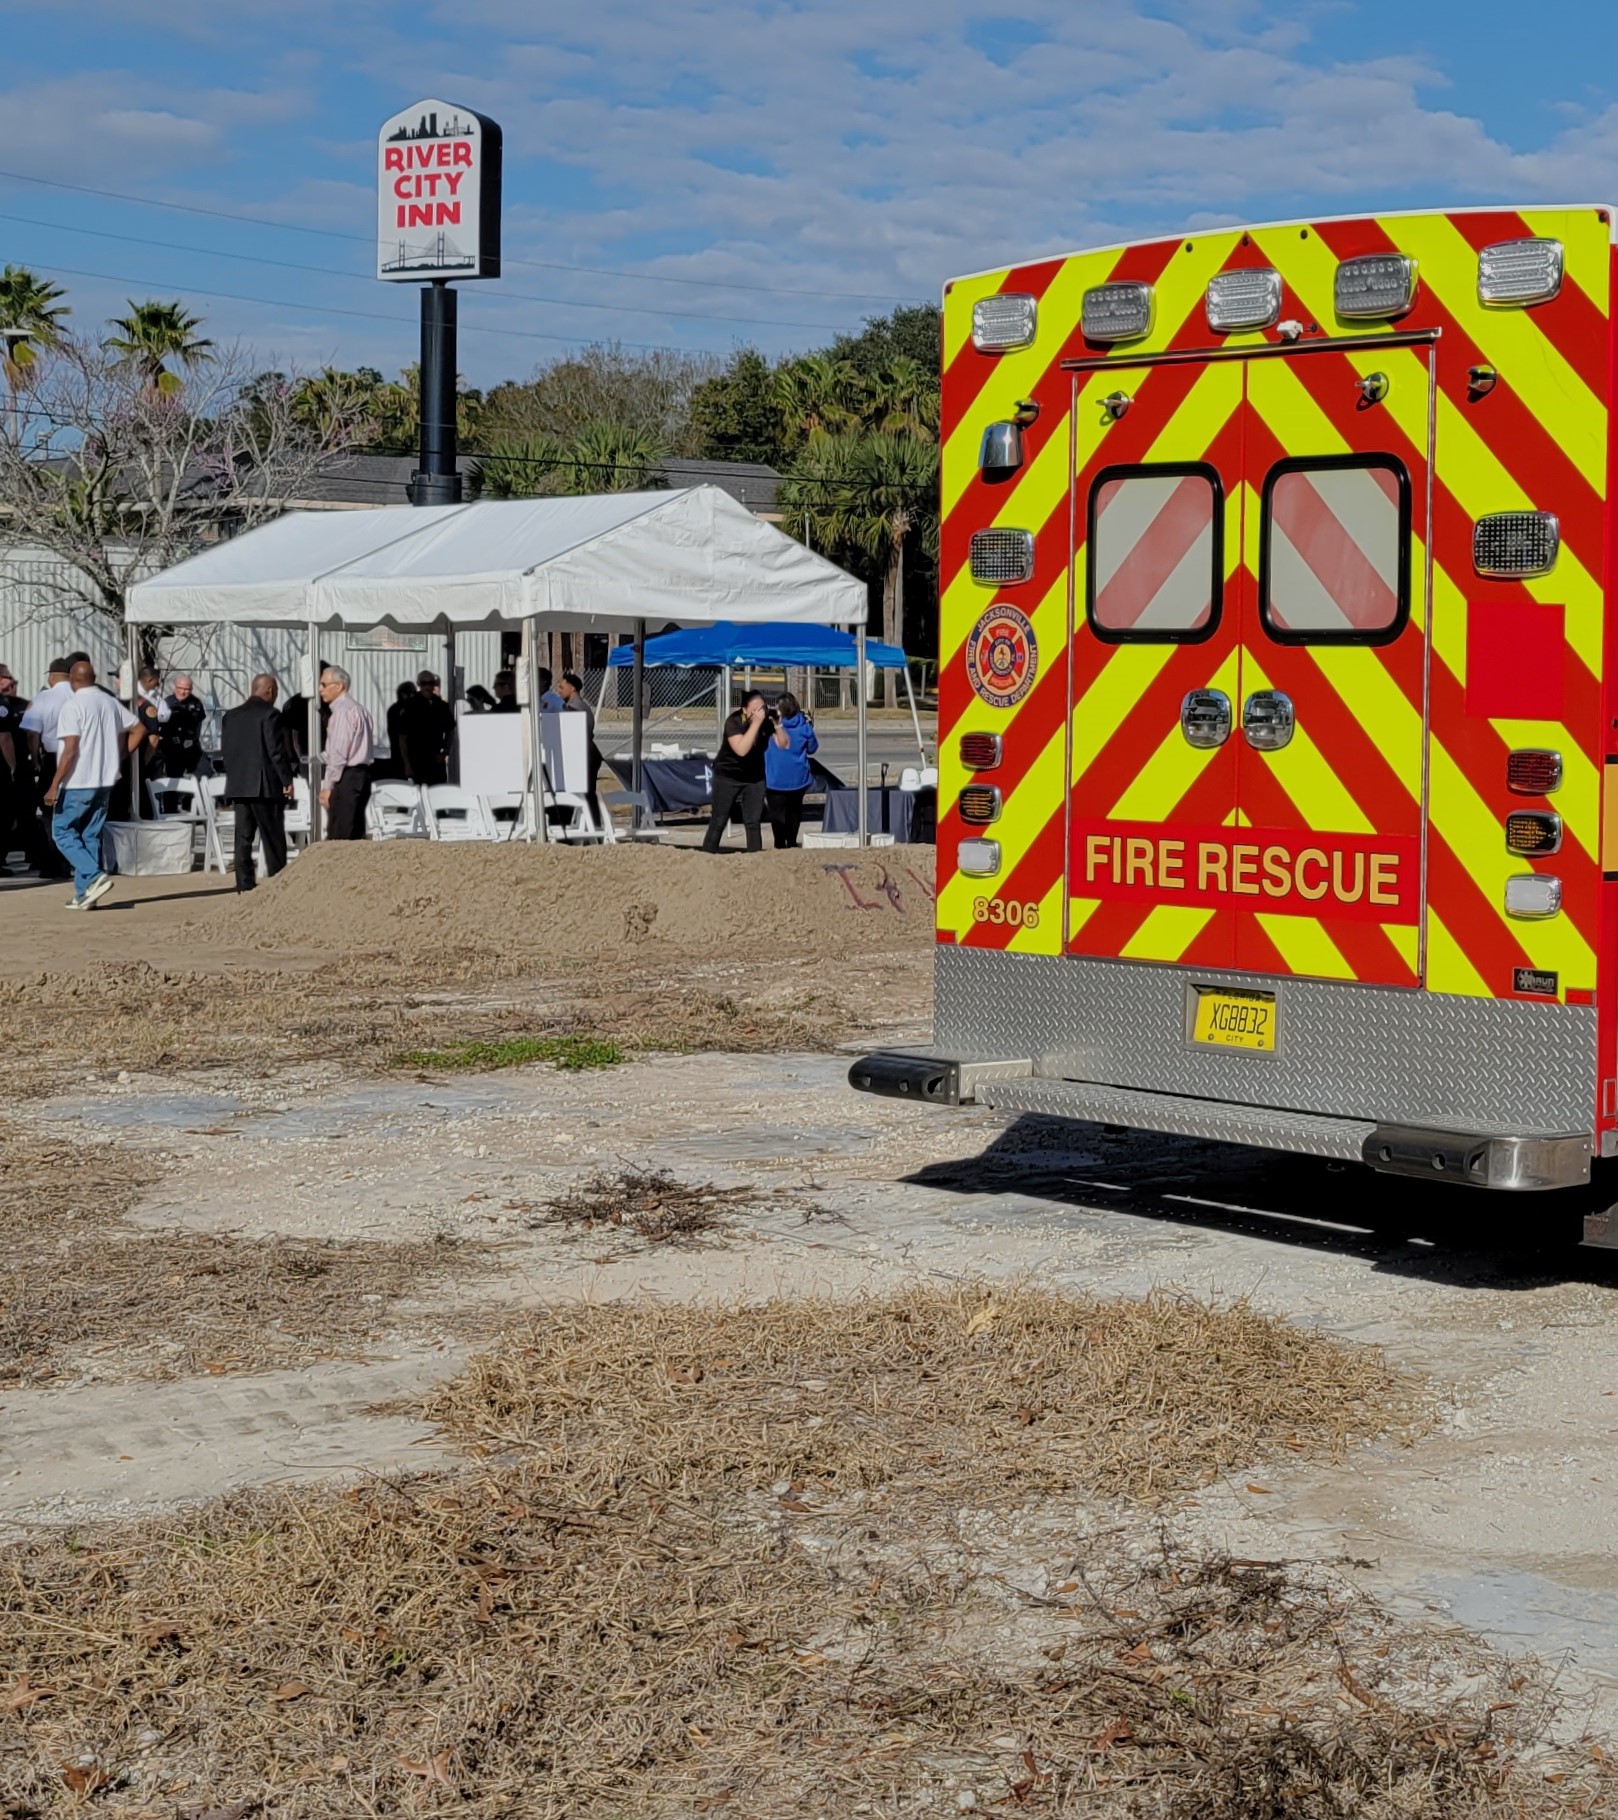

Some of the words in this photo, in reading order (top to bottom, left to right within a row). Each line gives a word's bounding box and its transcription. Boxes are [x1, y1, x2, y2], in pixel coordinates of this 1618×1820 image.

[385, 141, 473, 172] RIVER
[394, 171, 464, 199] CITY
[397, 201, 461, 228] INN
[977, 607, 1031, 634] JACKSONVILLE
[968, 640, 977, 663] FIRE
[968, 667, 981, 689] AND
[1010, 643, 1038, 703] DEPARTMENT
[979, 687, 1011, 707] RESCUE
[1086, 834, 1186, 889] FIRE
[1197, 841, 1400, 906] RESCUE
[973, 896, 1039, 929] 8306
[1209, 1002, 1268, 1035] XG8832
[1226, 1034, 1244, 1042] CITY
